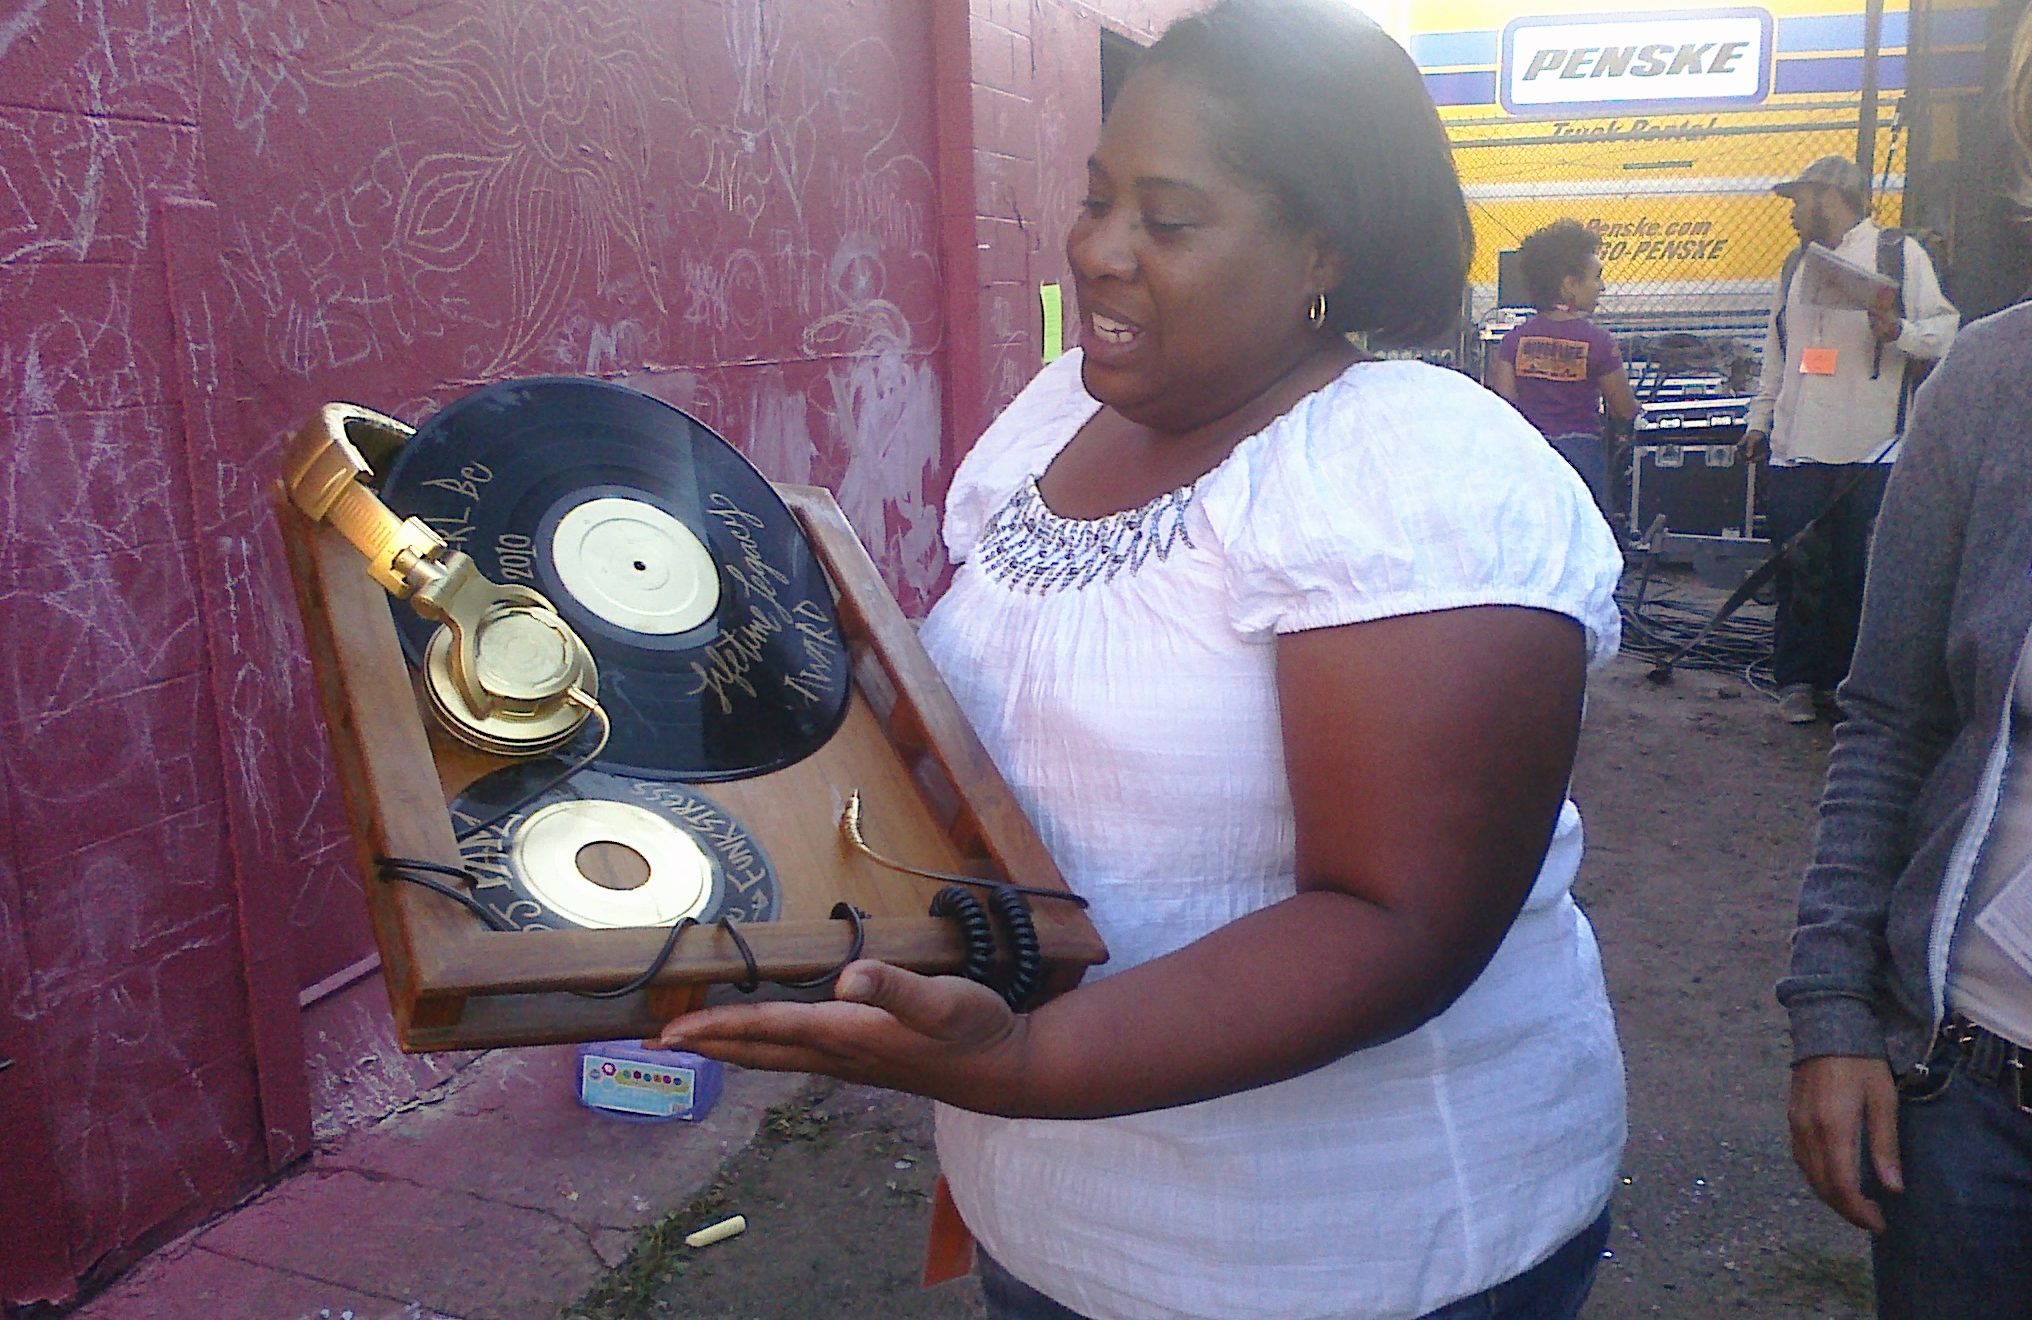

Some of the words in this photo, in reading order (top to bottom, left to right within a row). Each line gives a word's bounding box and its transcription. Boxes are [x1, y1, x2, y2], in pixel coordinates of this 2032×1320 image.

[1521, 40, 1751, 81] PENSKE
[494, 533, 537, 580] 2010
[783, 600, 838, 704] AWARD
